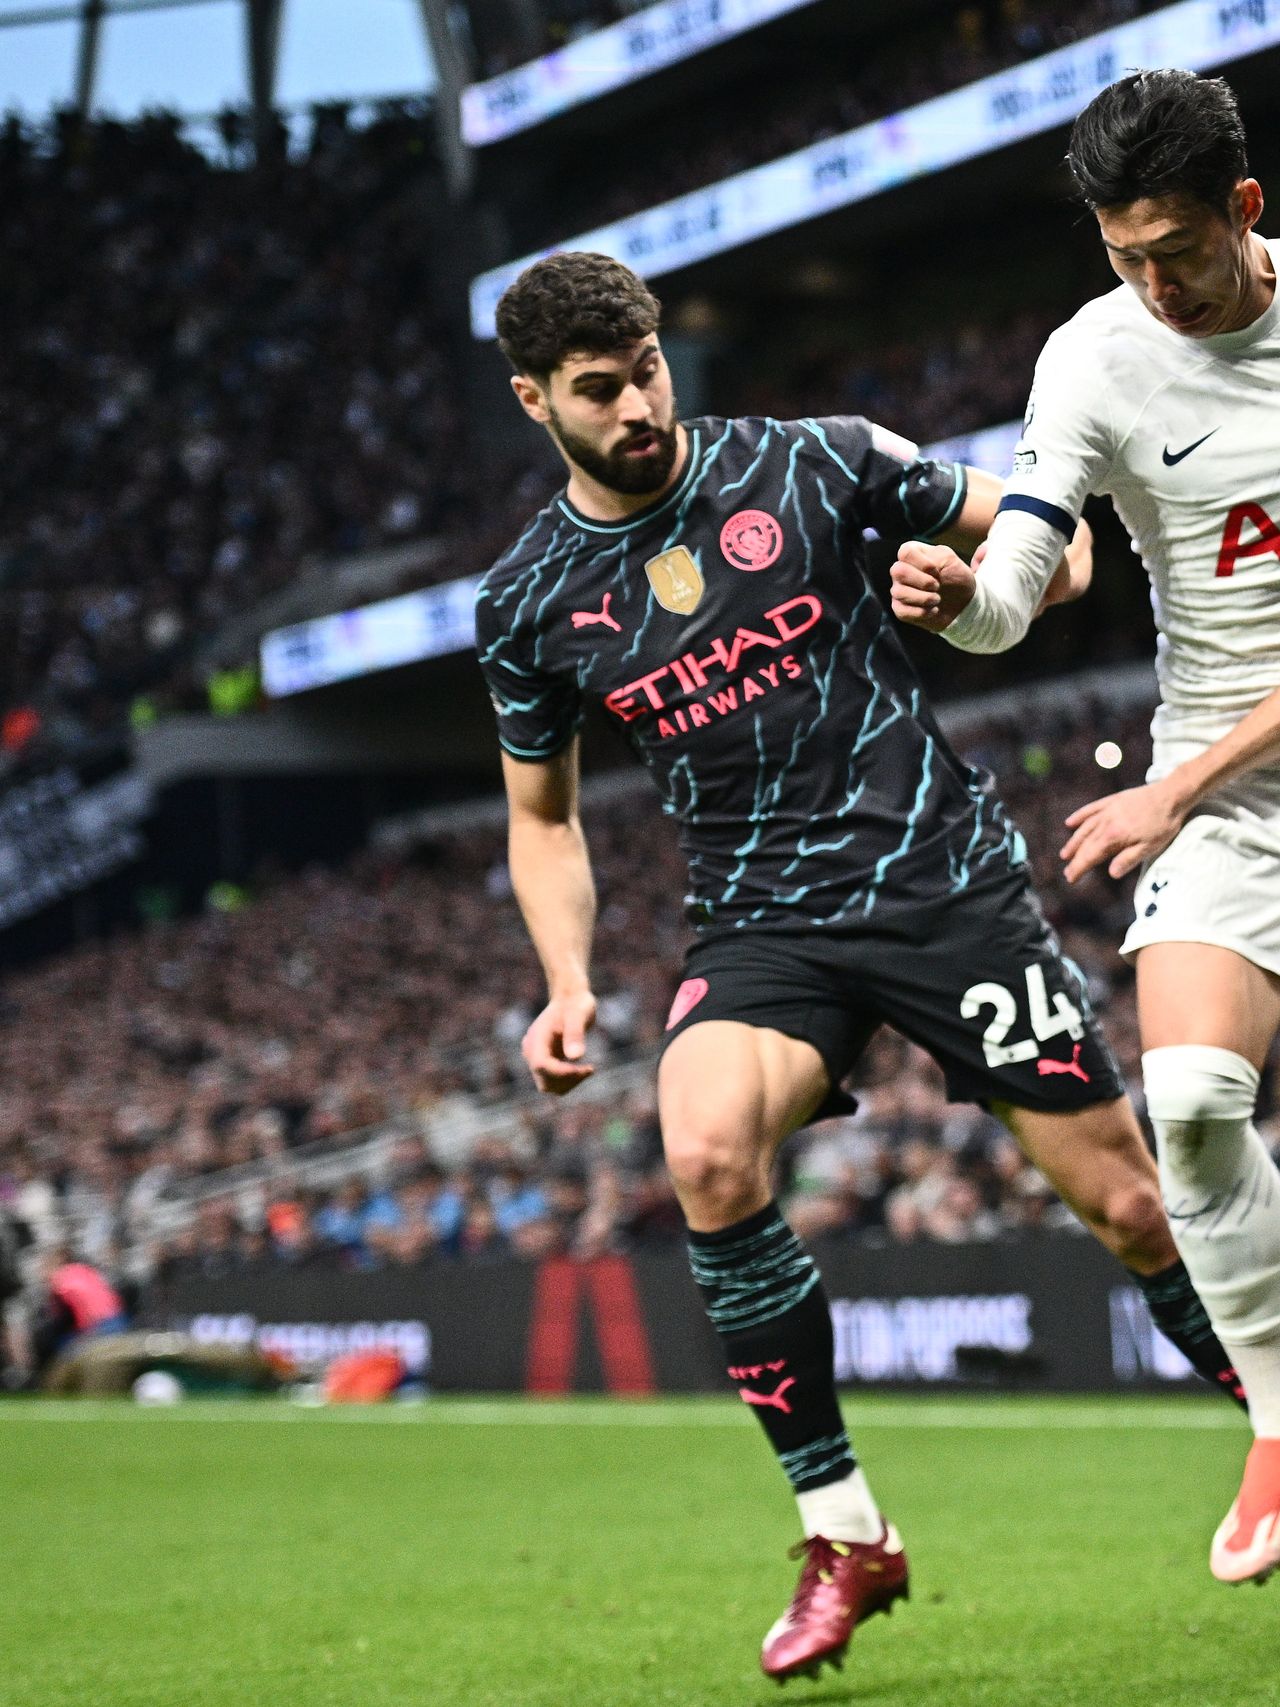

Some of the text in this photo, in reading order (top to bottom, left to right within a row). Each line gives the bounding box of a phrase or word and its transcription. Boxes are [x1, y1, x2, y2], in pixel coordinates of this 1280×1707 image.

[604, 594, 823, 722] ETIHAD
[657, 655, 802, 738] AIRWAYS
[960, 963, 1086, 1068] 24
